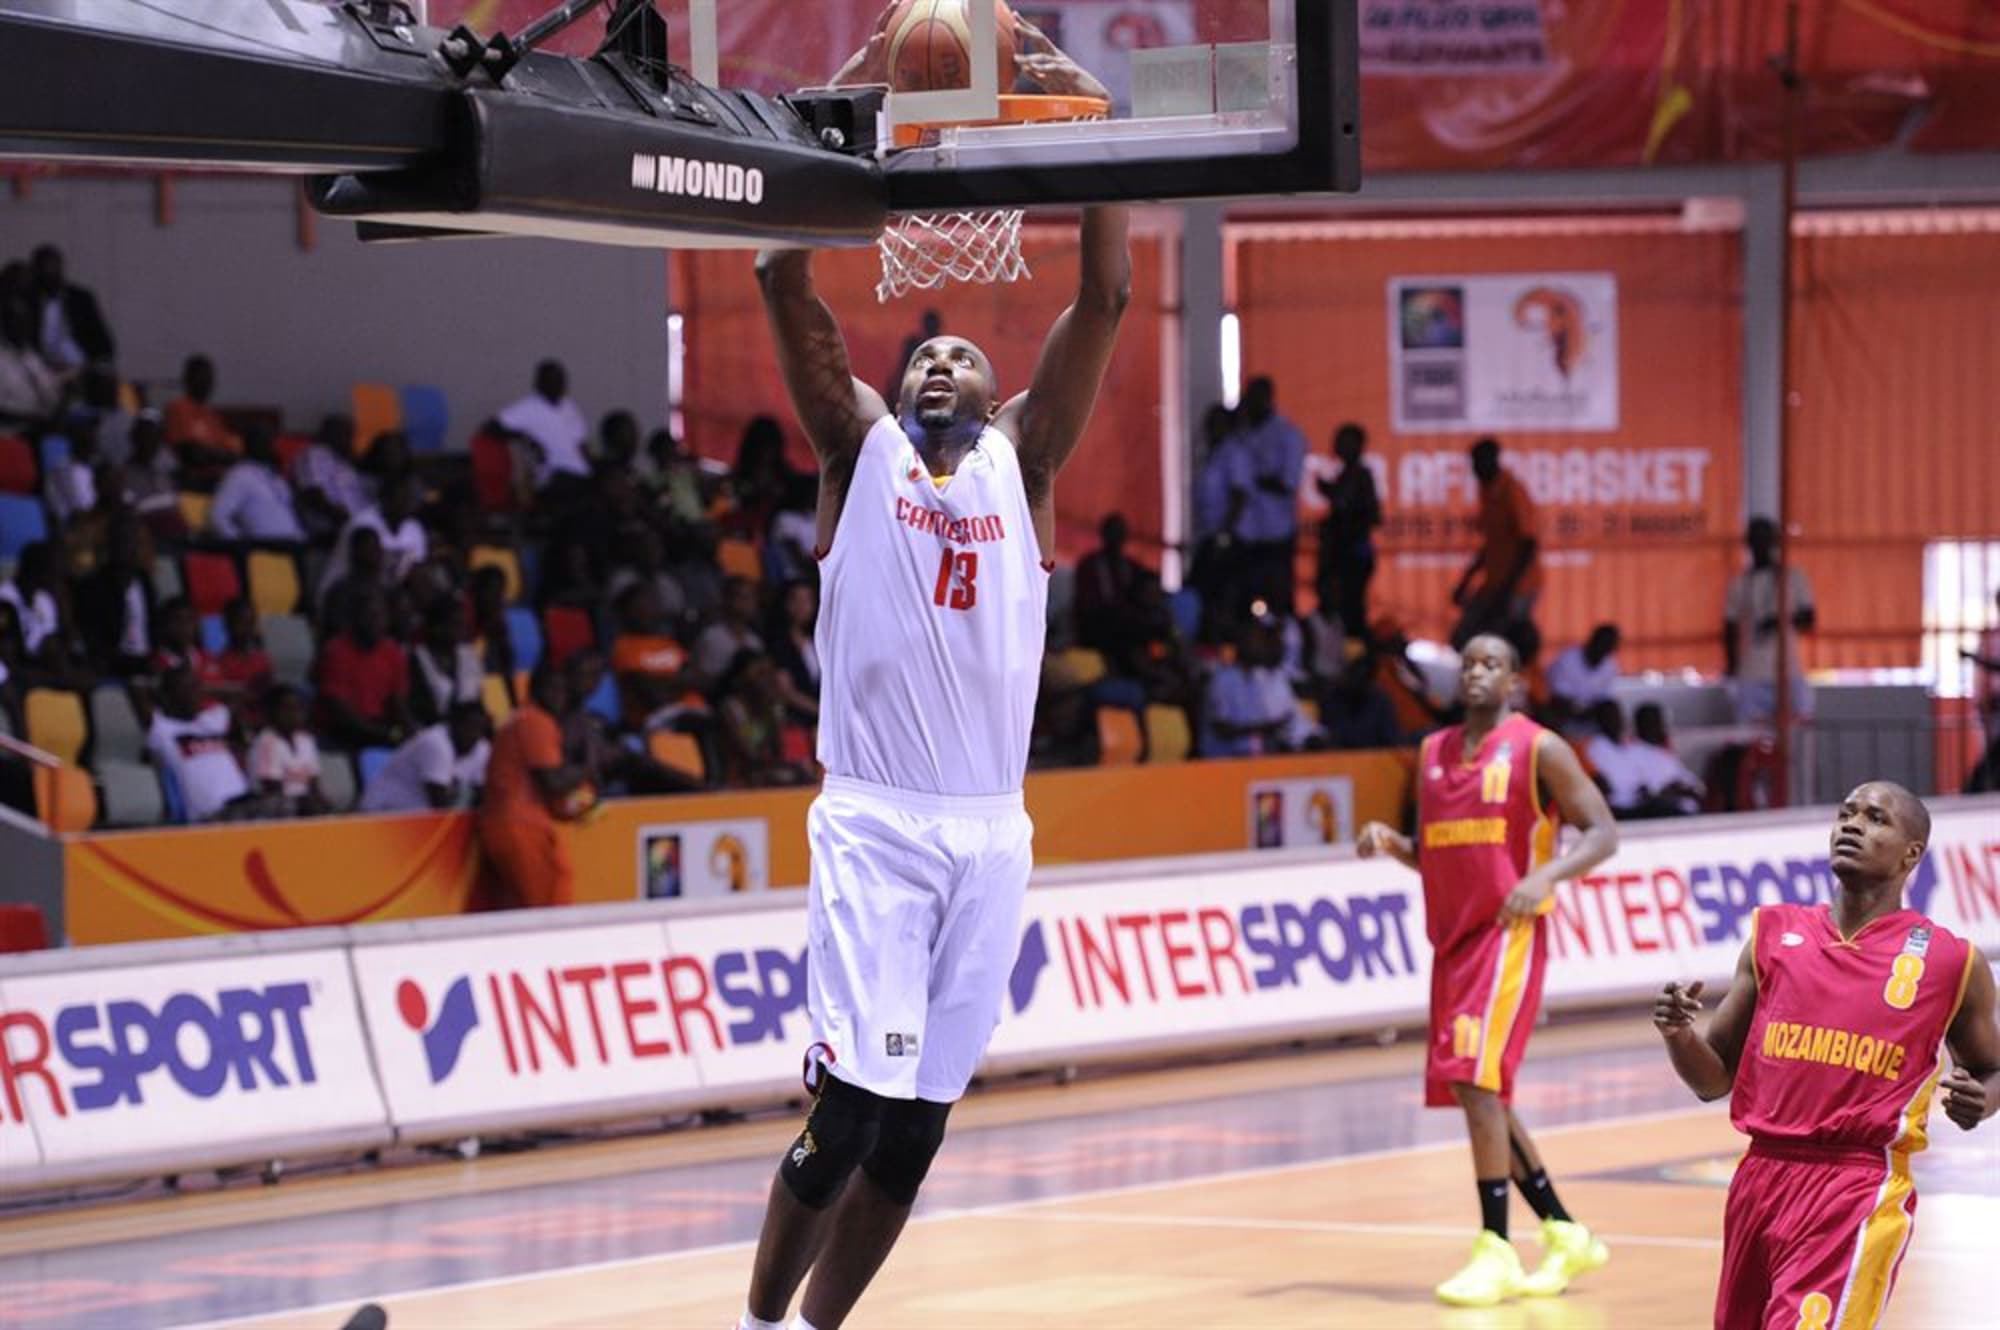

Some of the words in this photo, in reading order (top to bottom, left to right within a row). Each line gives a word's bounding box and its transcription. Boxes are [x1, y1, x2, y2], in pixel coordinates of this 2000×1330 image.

[657, 155, 763, 204] MONDO
[1399, 448, 1712, 507] AFBASKET
[934, 547, 978, 610] 13
[1944, 843, 2000, 922] IN
[1057, 892, 1415, 1008] INTERSPORT
[488, 947, 808, 1075] INTERSP
[1884, 953, 1925, 1010] 8
[0, 982, 317, 1125] RSPORT
[1763, 1021, 1905, 1081] MOZAMBIQUE
[1795, 1291, 1833, 1330] 8
